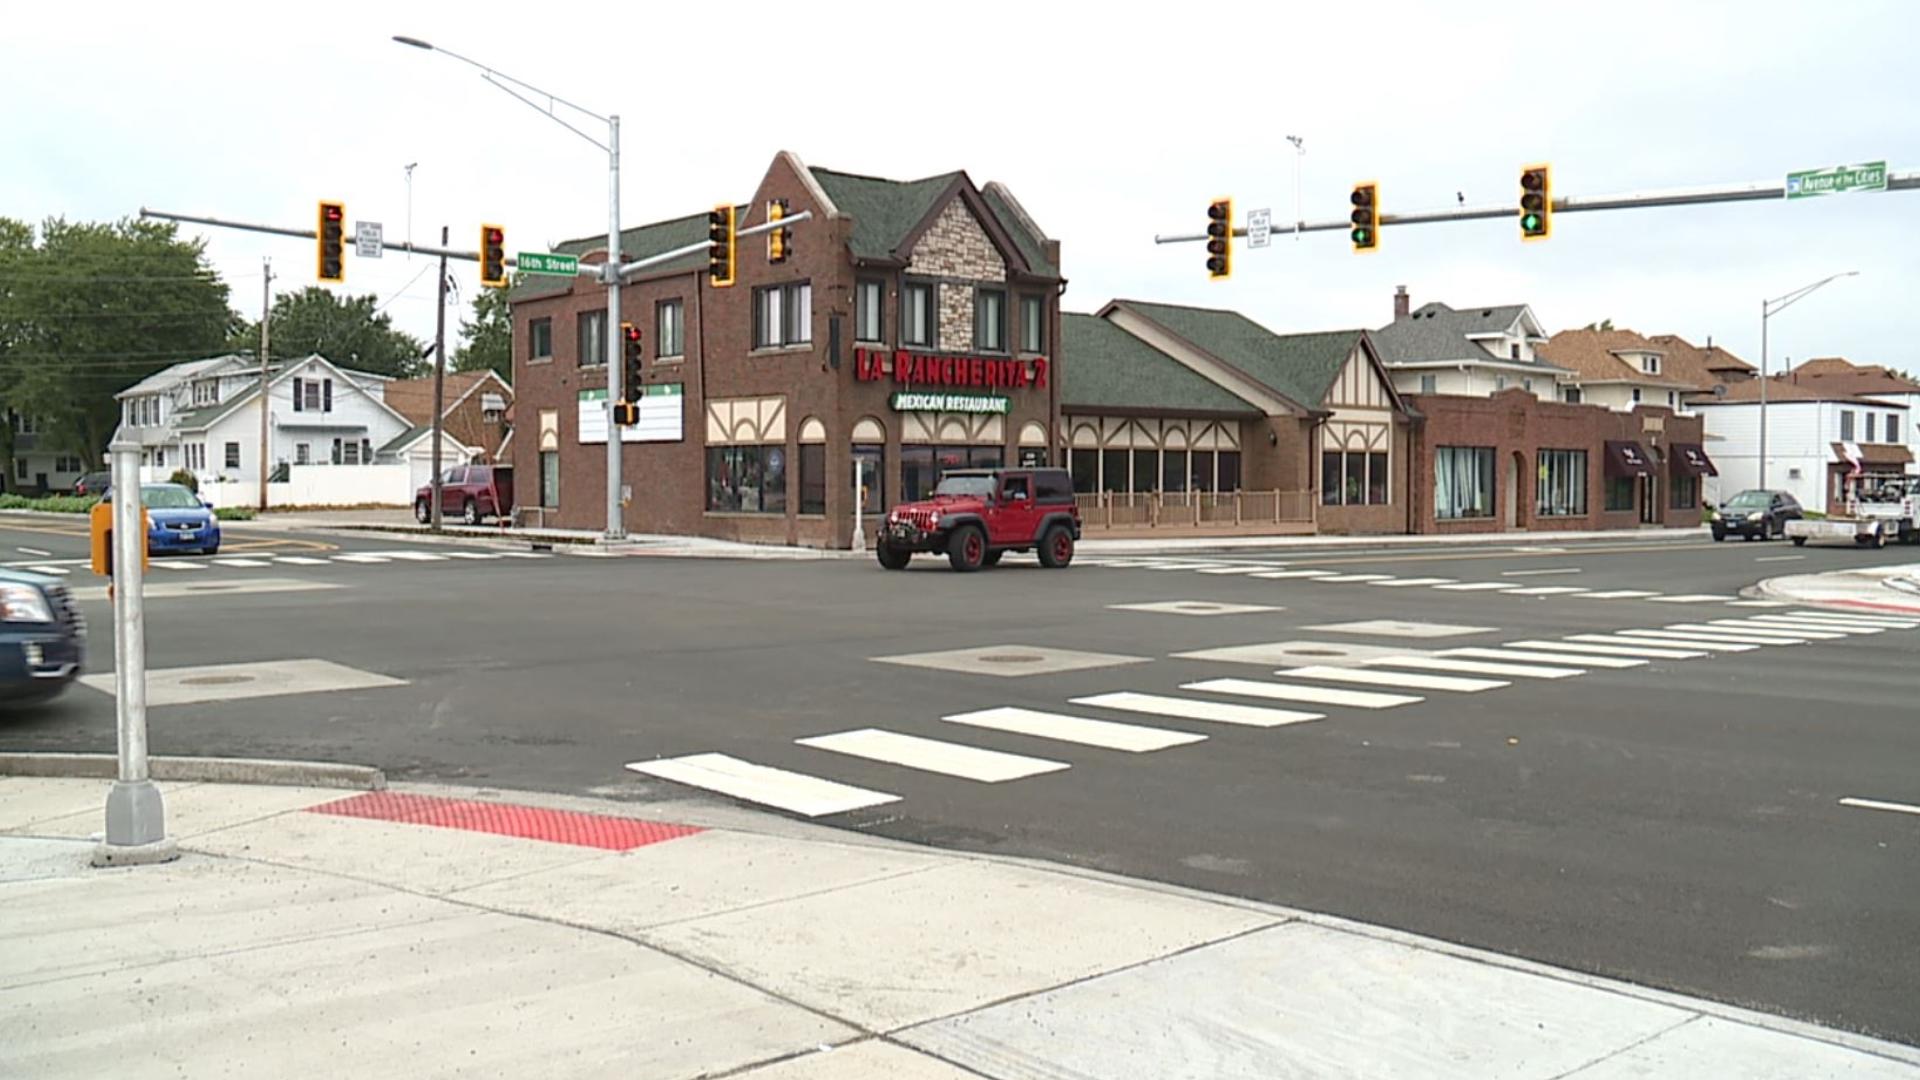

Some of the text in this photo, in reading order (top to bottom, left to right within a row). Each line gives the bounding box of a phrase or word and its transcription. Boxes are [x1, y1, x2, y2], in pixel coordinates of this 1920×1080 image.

[1804, 177, 1834, 192] Avenue
[1855, 169, 1881, 182] Cities
[520, 255, 575, 272] 16th Street
[857, 348, 1047, 389] LA RANCHERITA 2
[894, 393, 1007, 411] MEXICAN RESTAURANT
